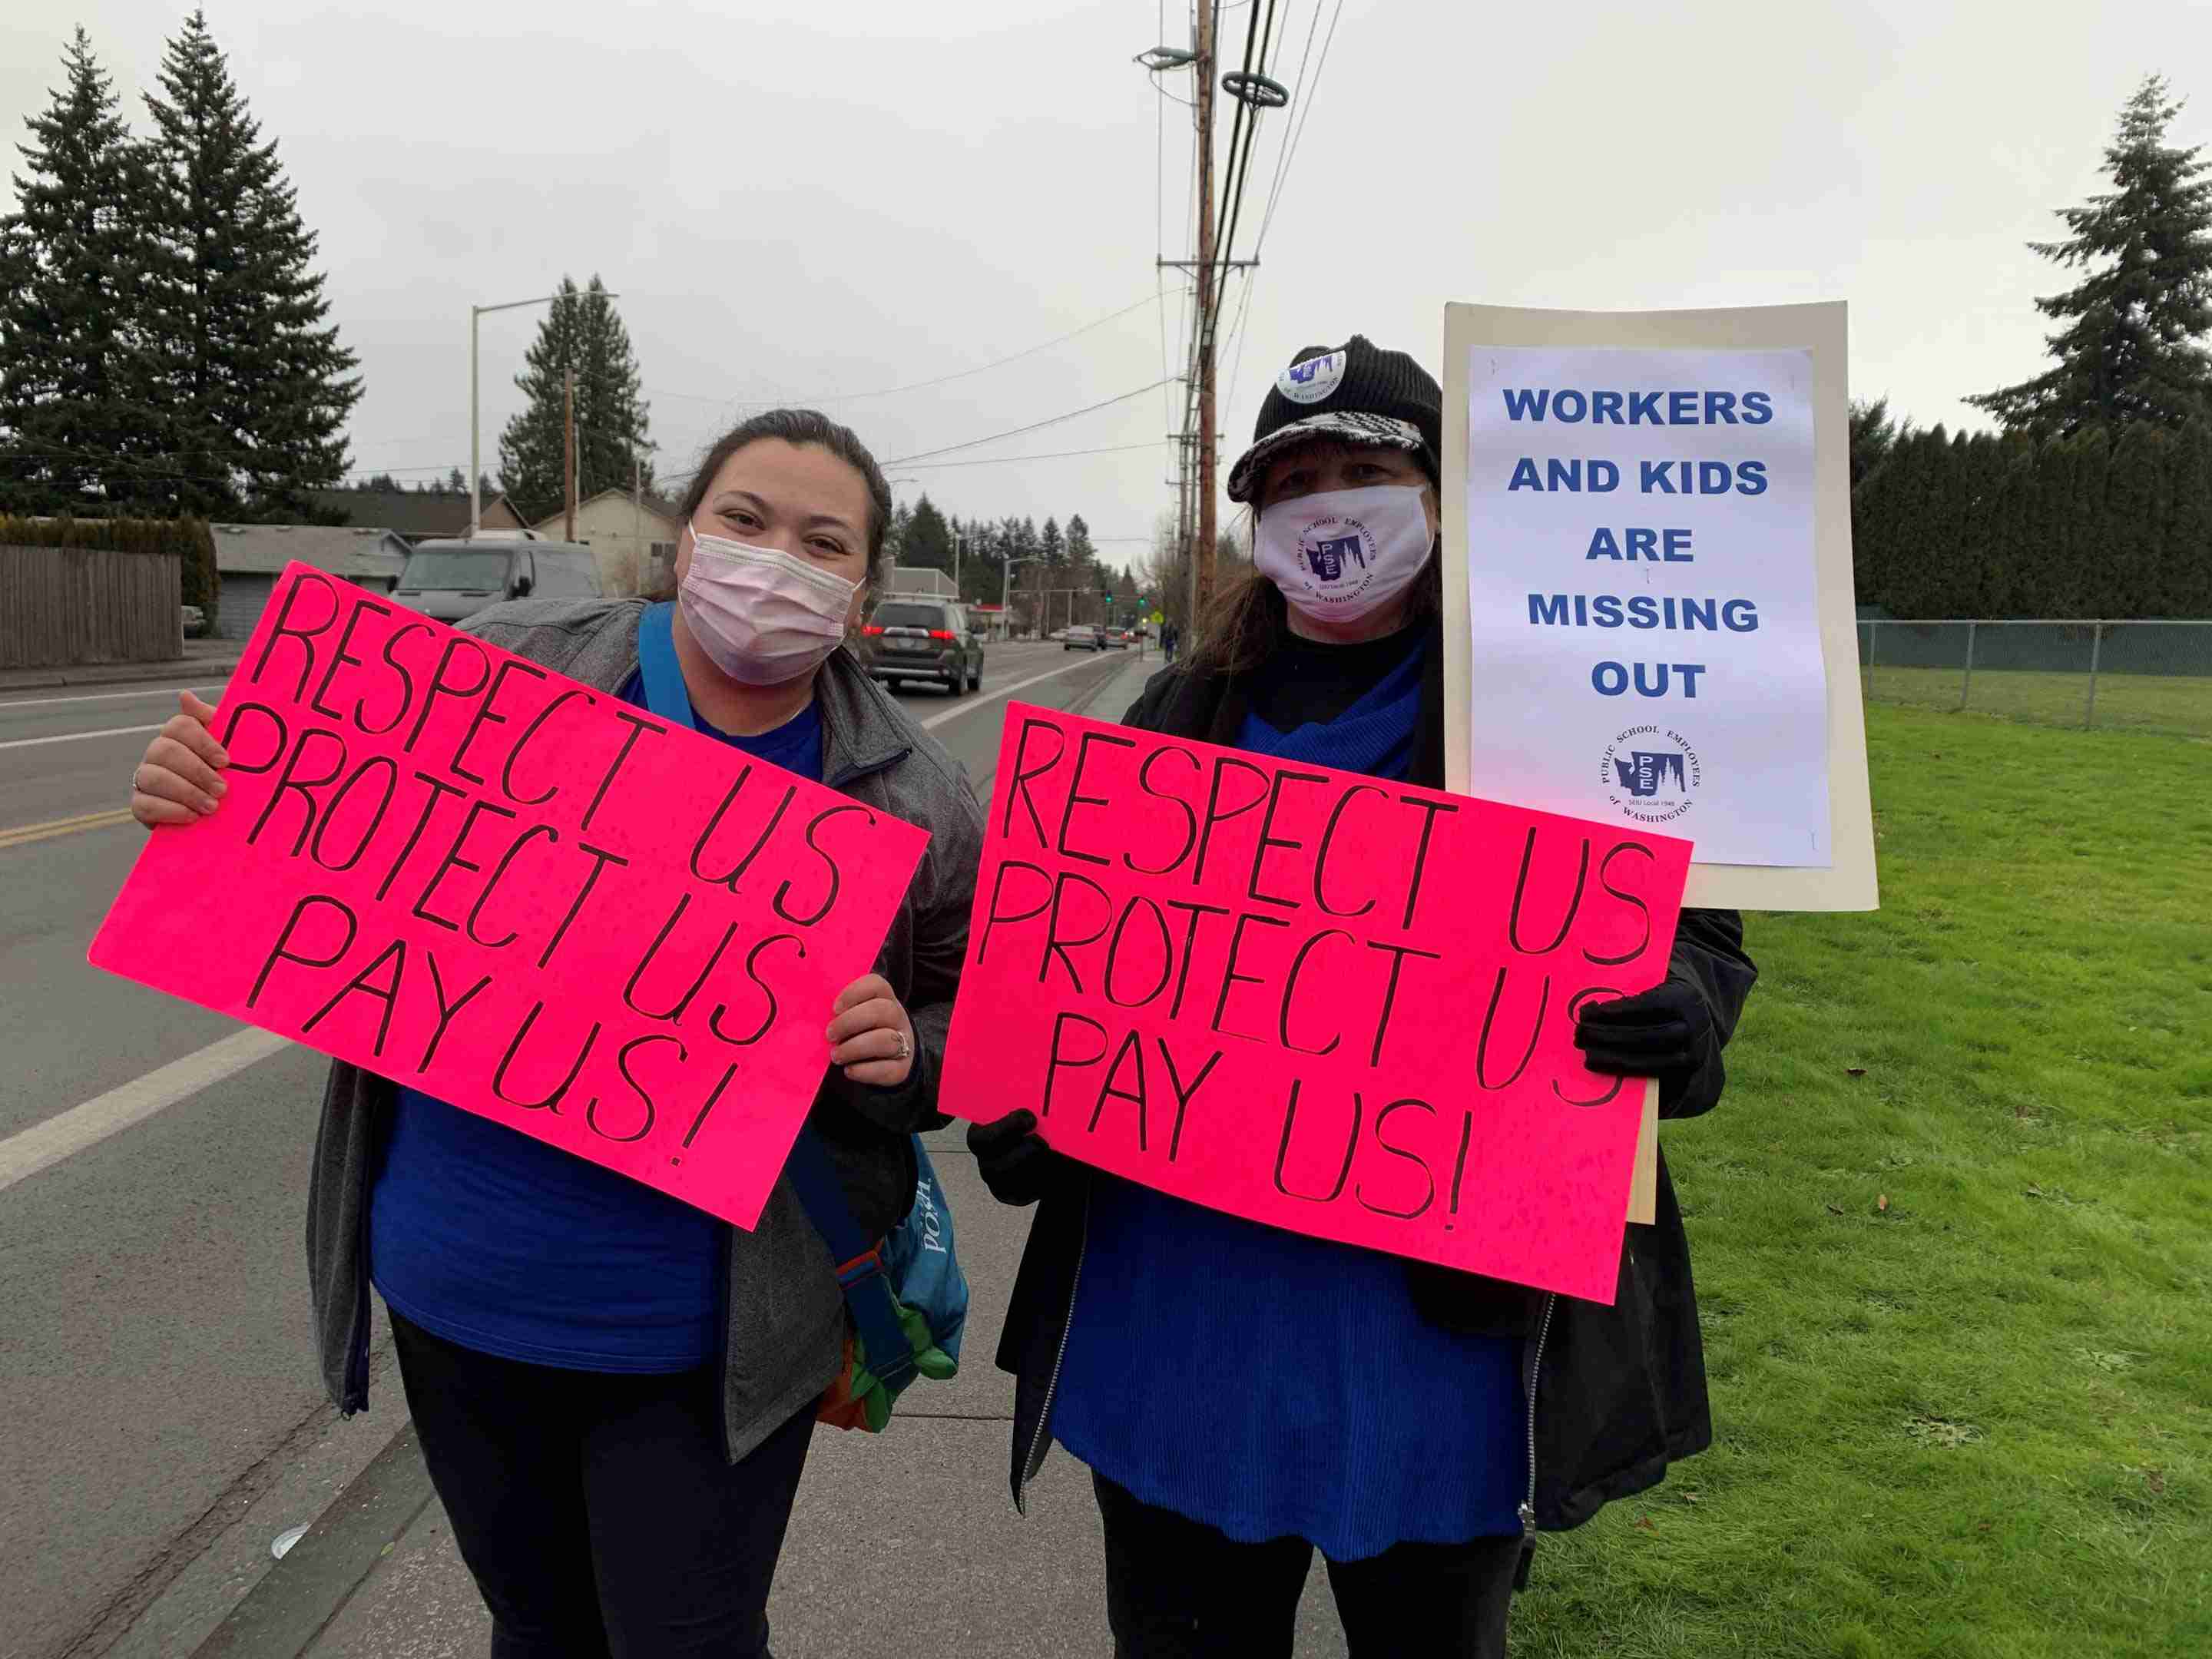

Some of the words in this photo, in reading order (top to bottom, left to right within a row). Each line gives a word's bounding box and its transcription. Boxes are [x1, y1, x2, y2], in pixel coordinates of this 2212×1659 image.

[1502, 389, 1773, 425] WORKERS
[1508, 457, 1620, 492] AND
[1640, 460, 1768, 495] KIDS
[1303, 517, 1339, 535] SCHOOL
[1344, 518, 1377, 561] EMPLOYEES
[1585, 528, 1694, 562] ARE
[1321, 543, 1338, 575] PSE
[1316, 572, 1374, 603] WASHINGTON
[1528, 594, 1759, 633] MISSING
[1591, 661, 1706, 698] OUT
[250, 573, 667, 831] RESPECT
[690, 763, 876, 927] US
[1601, 743, 1616, 784] PUBLIC
[1616, 725, 1660, 743] SCHOOL
[1666, 730, 1700, 787] EMPLOYEES
[1639, 756, 1654, 790] PSE
[1609, 795, 1621, 805] of
[1623, 799, 1694, 823] WASHINGTON
[1002, 718, 1459, 930] RESPECT
[1508, 826, 1657, 965] US
[221, 702, 629, 969] PROTECT
[623, 892, 806, 1046] US
[977, 859, 1441, 1068] PROTECT
[246, 893, 493, 1074] PAY
[492, 1000, 739, 1167] US!
[1042, 1012, 1224, 1162] PAY
[1273, 1078, 1474, 1232] US!
